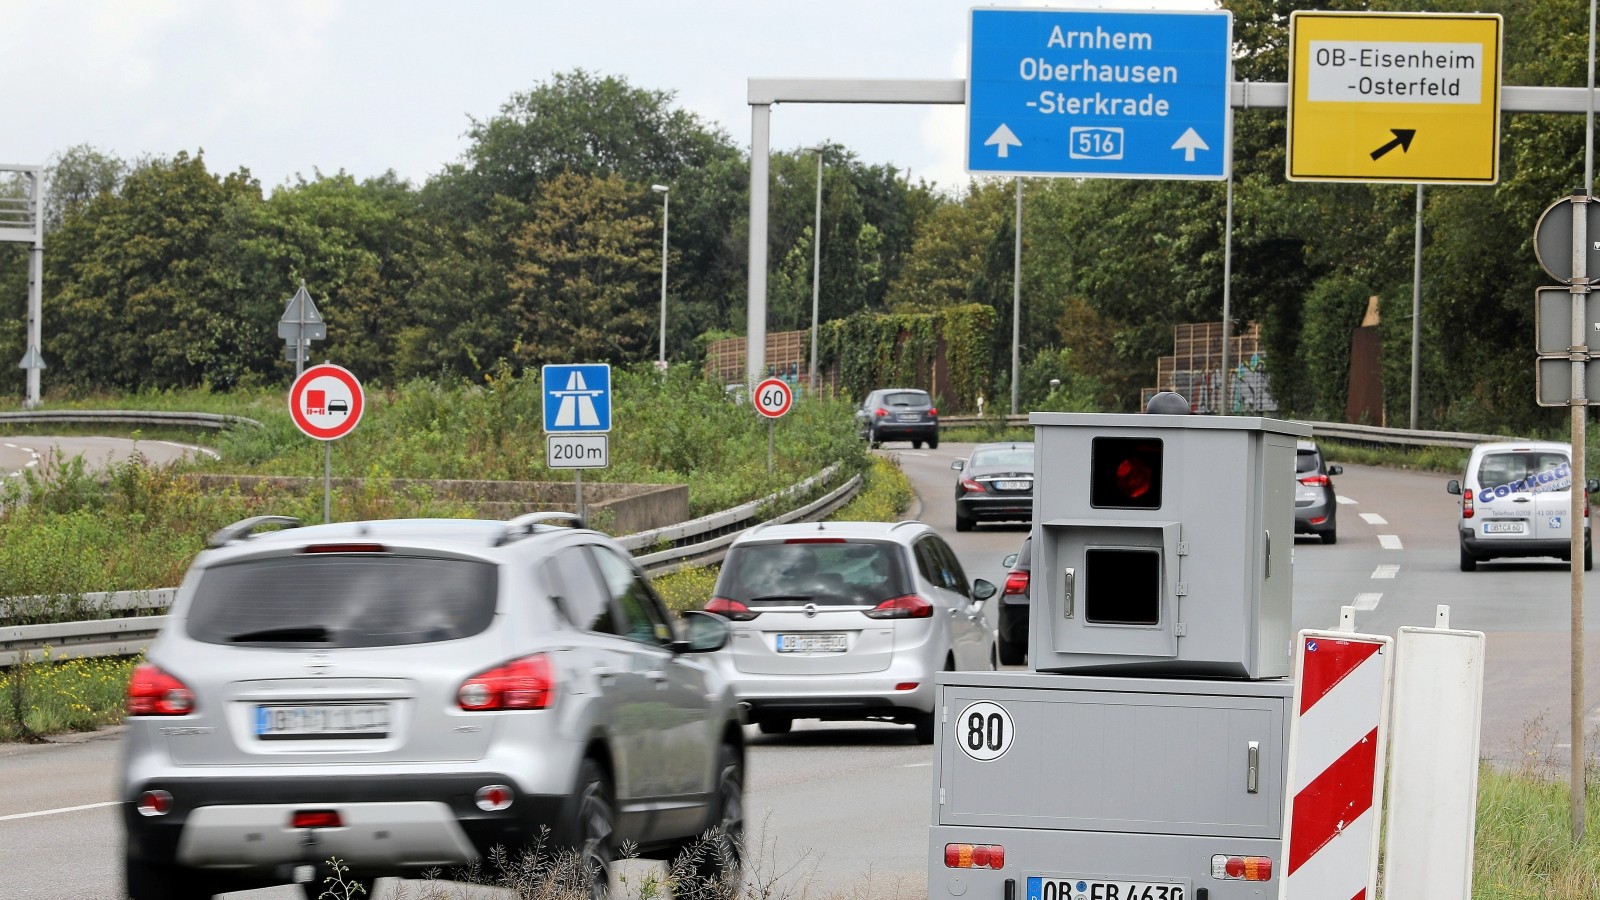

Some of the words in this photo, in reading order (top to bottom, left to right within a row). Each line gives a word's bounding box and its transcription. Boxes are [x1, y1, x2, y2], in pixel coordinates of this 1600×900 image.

[1047, 25, 1152, 50] Arnhem
[1316, 48, 1475, 70] OB-Eisenheim
[1019, 57, 1178, 84] Oberhausen
[1348, 76, 1460, 96] -Osterfeld
[1026, 90, 1170, 117] -Sterkrade
[1079, 133, 1114, 153] 516
[763, 390, 783, 406] 60
[553, 444, 584, 460] 200
[587, 447, 602, 459] m
[967, 712, 1004, 752] 80
[1043, 881, 1072, 900] OB
